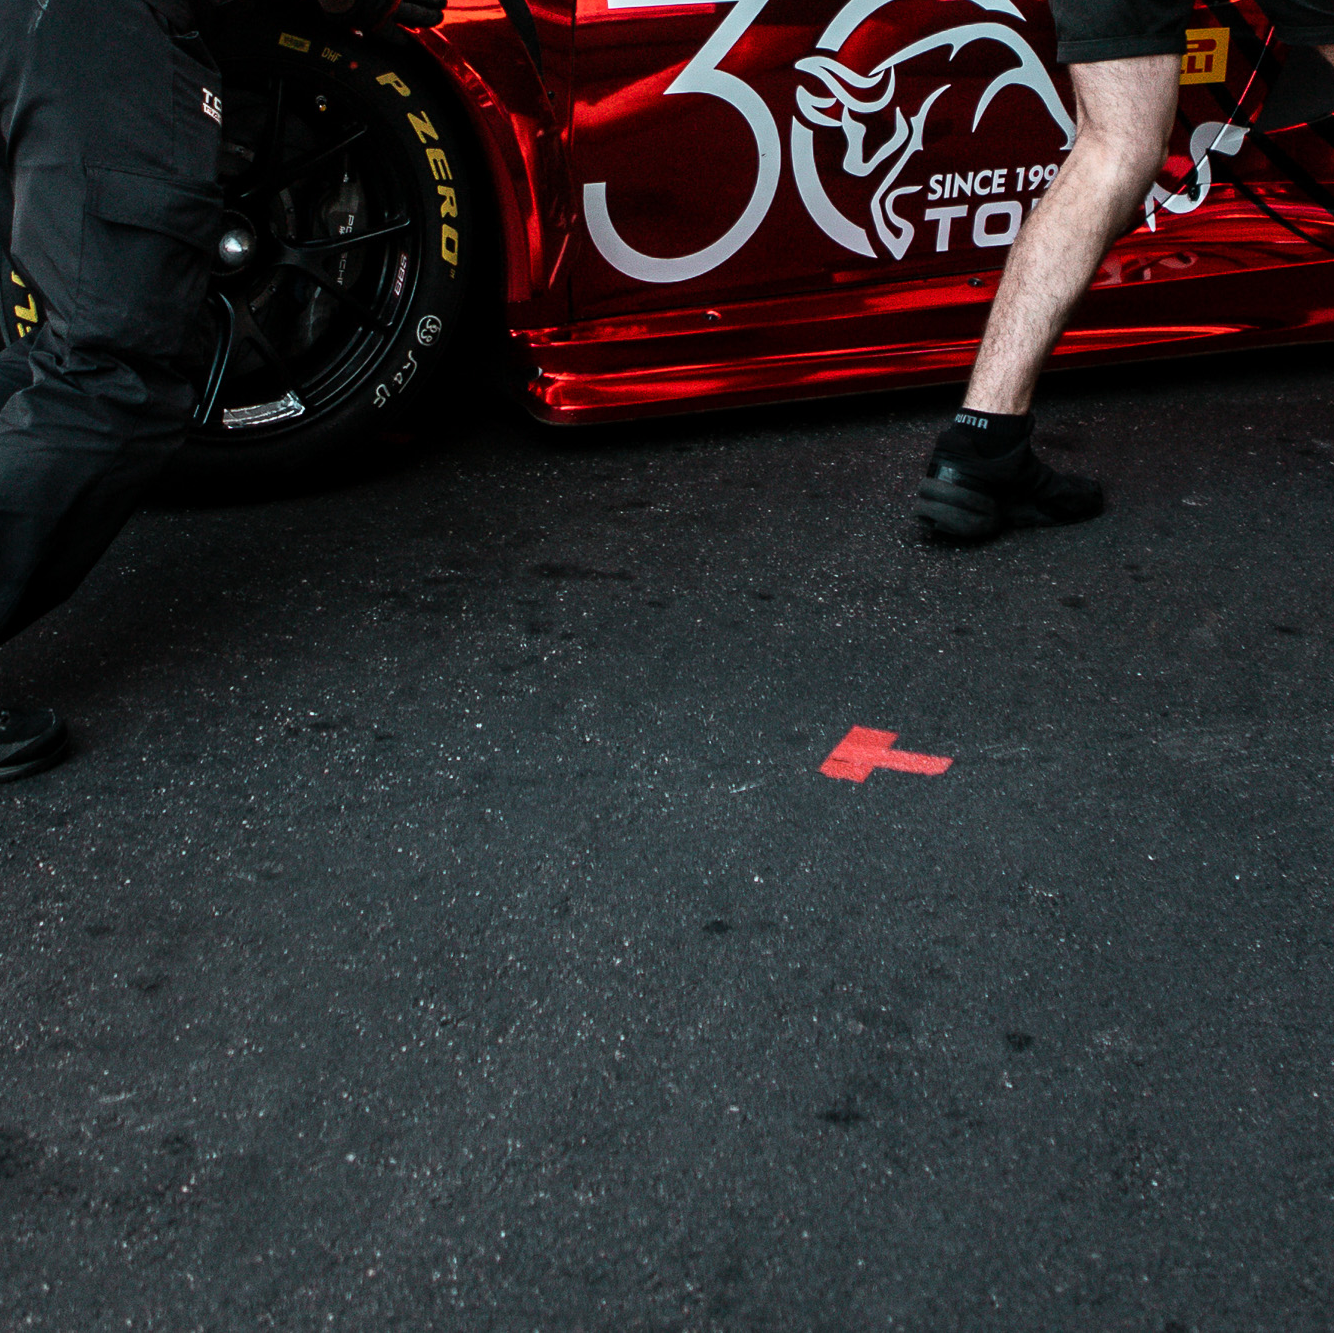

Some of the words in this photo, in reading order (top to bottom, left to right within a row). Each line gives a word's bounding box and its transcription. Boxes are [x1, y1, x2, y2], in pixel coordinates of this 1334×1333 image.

[927, 168, 1008, 201] SINCE
[1015, 162, 1062, 192] 199
[924, 198, 1041, 252] TO
[393, 253, 408, 296] BBS
